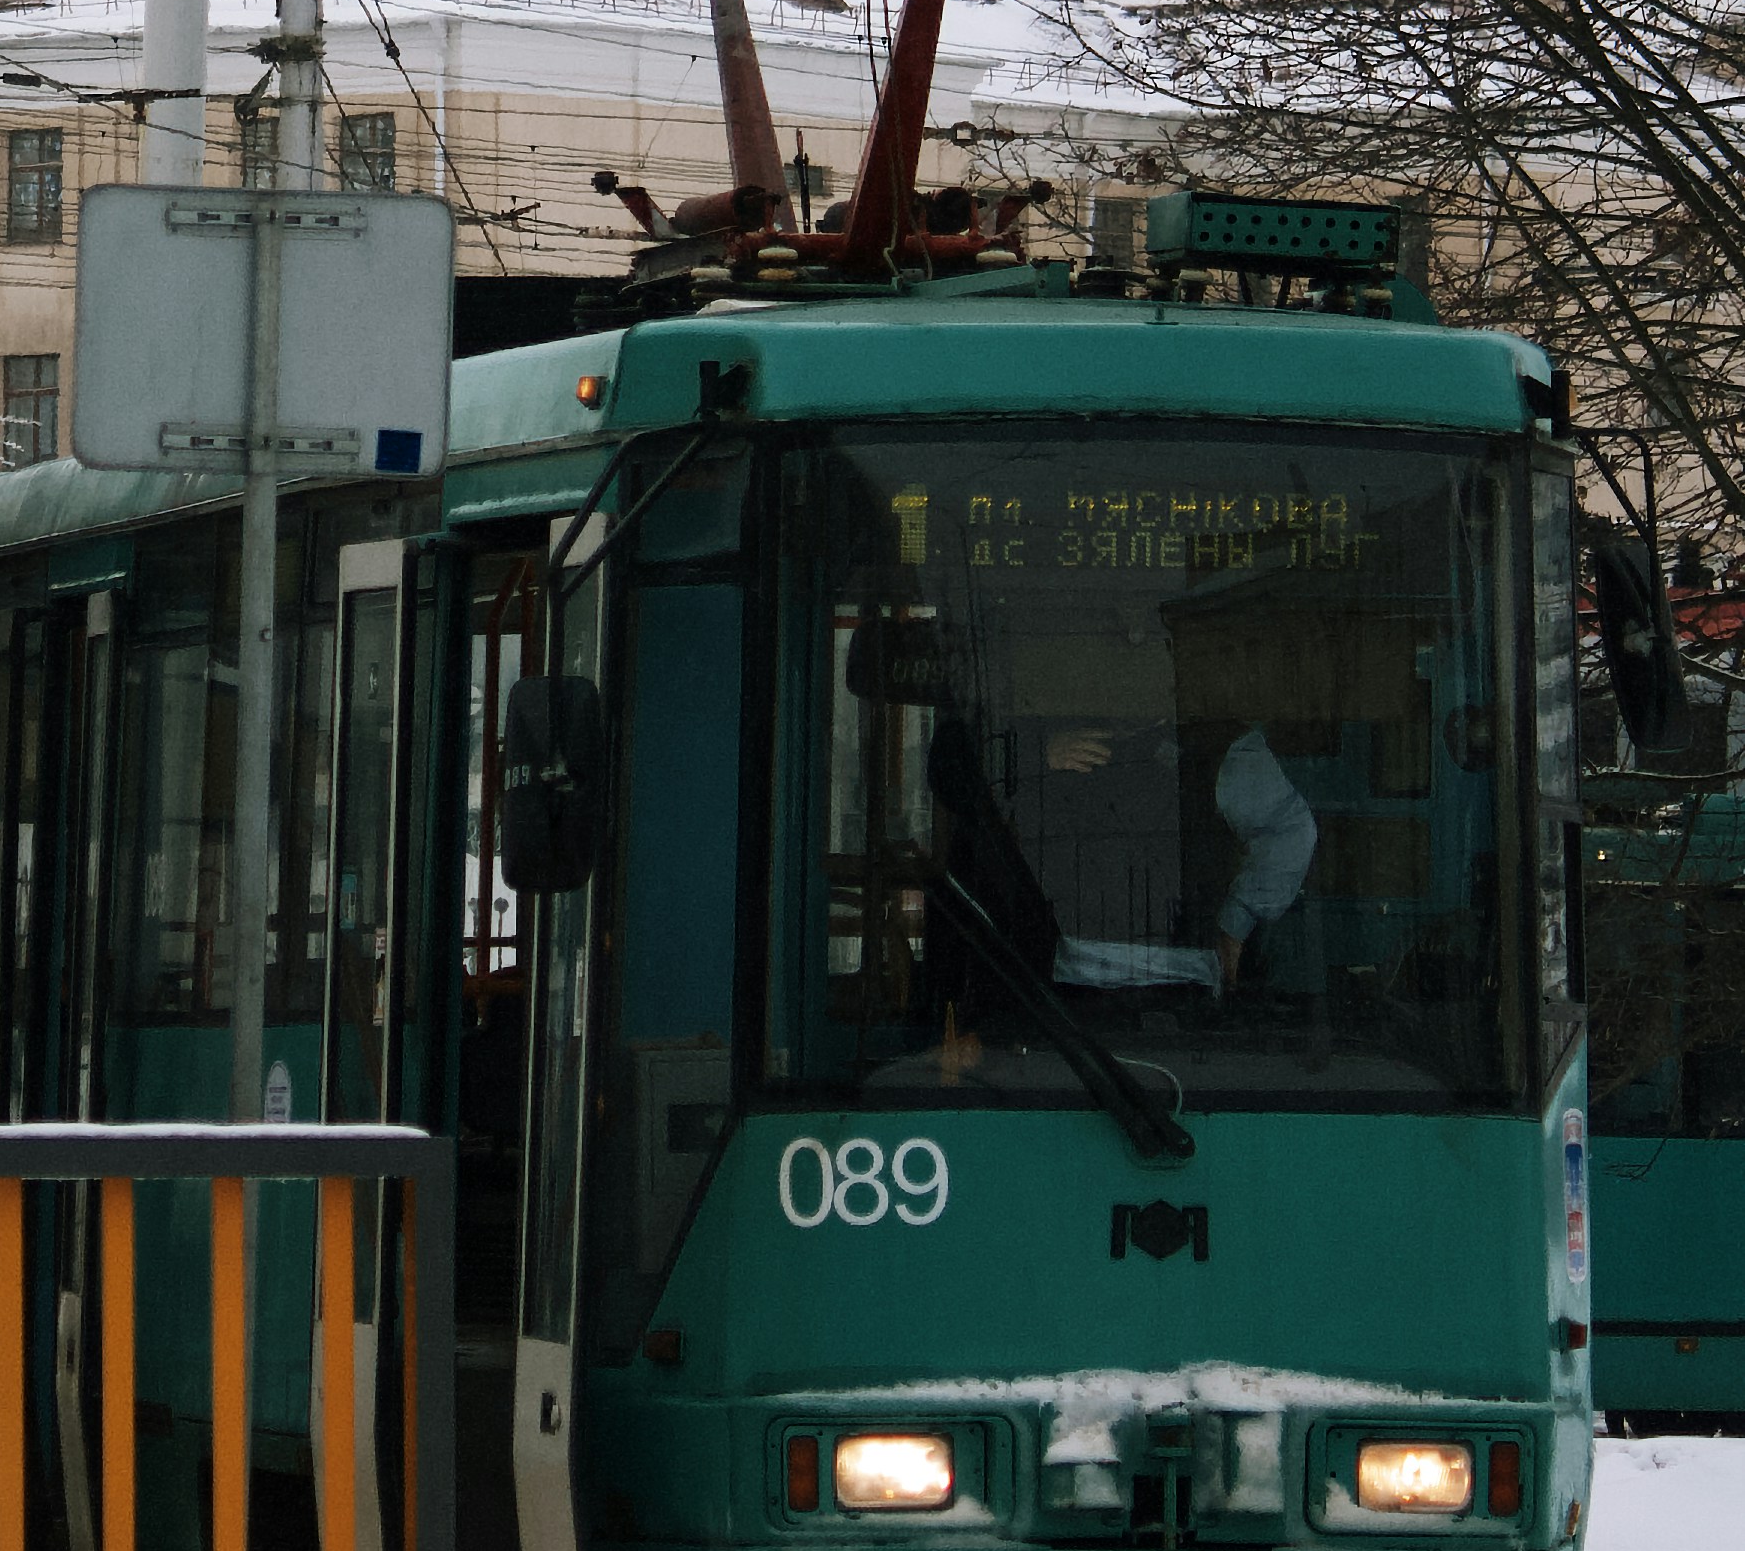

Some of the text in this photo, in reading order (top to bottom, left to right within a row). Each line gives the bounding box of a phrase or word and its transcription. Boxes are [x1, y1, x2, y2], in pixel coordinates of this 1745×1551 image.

[891, 483, 929, 565] 1
[1057, 529, 1254, 569] ЗЯЛЕНЫ
[1285, 531, 1381, 570] ЛУГ
[779, 1137, 949, 1228] 089
